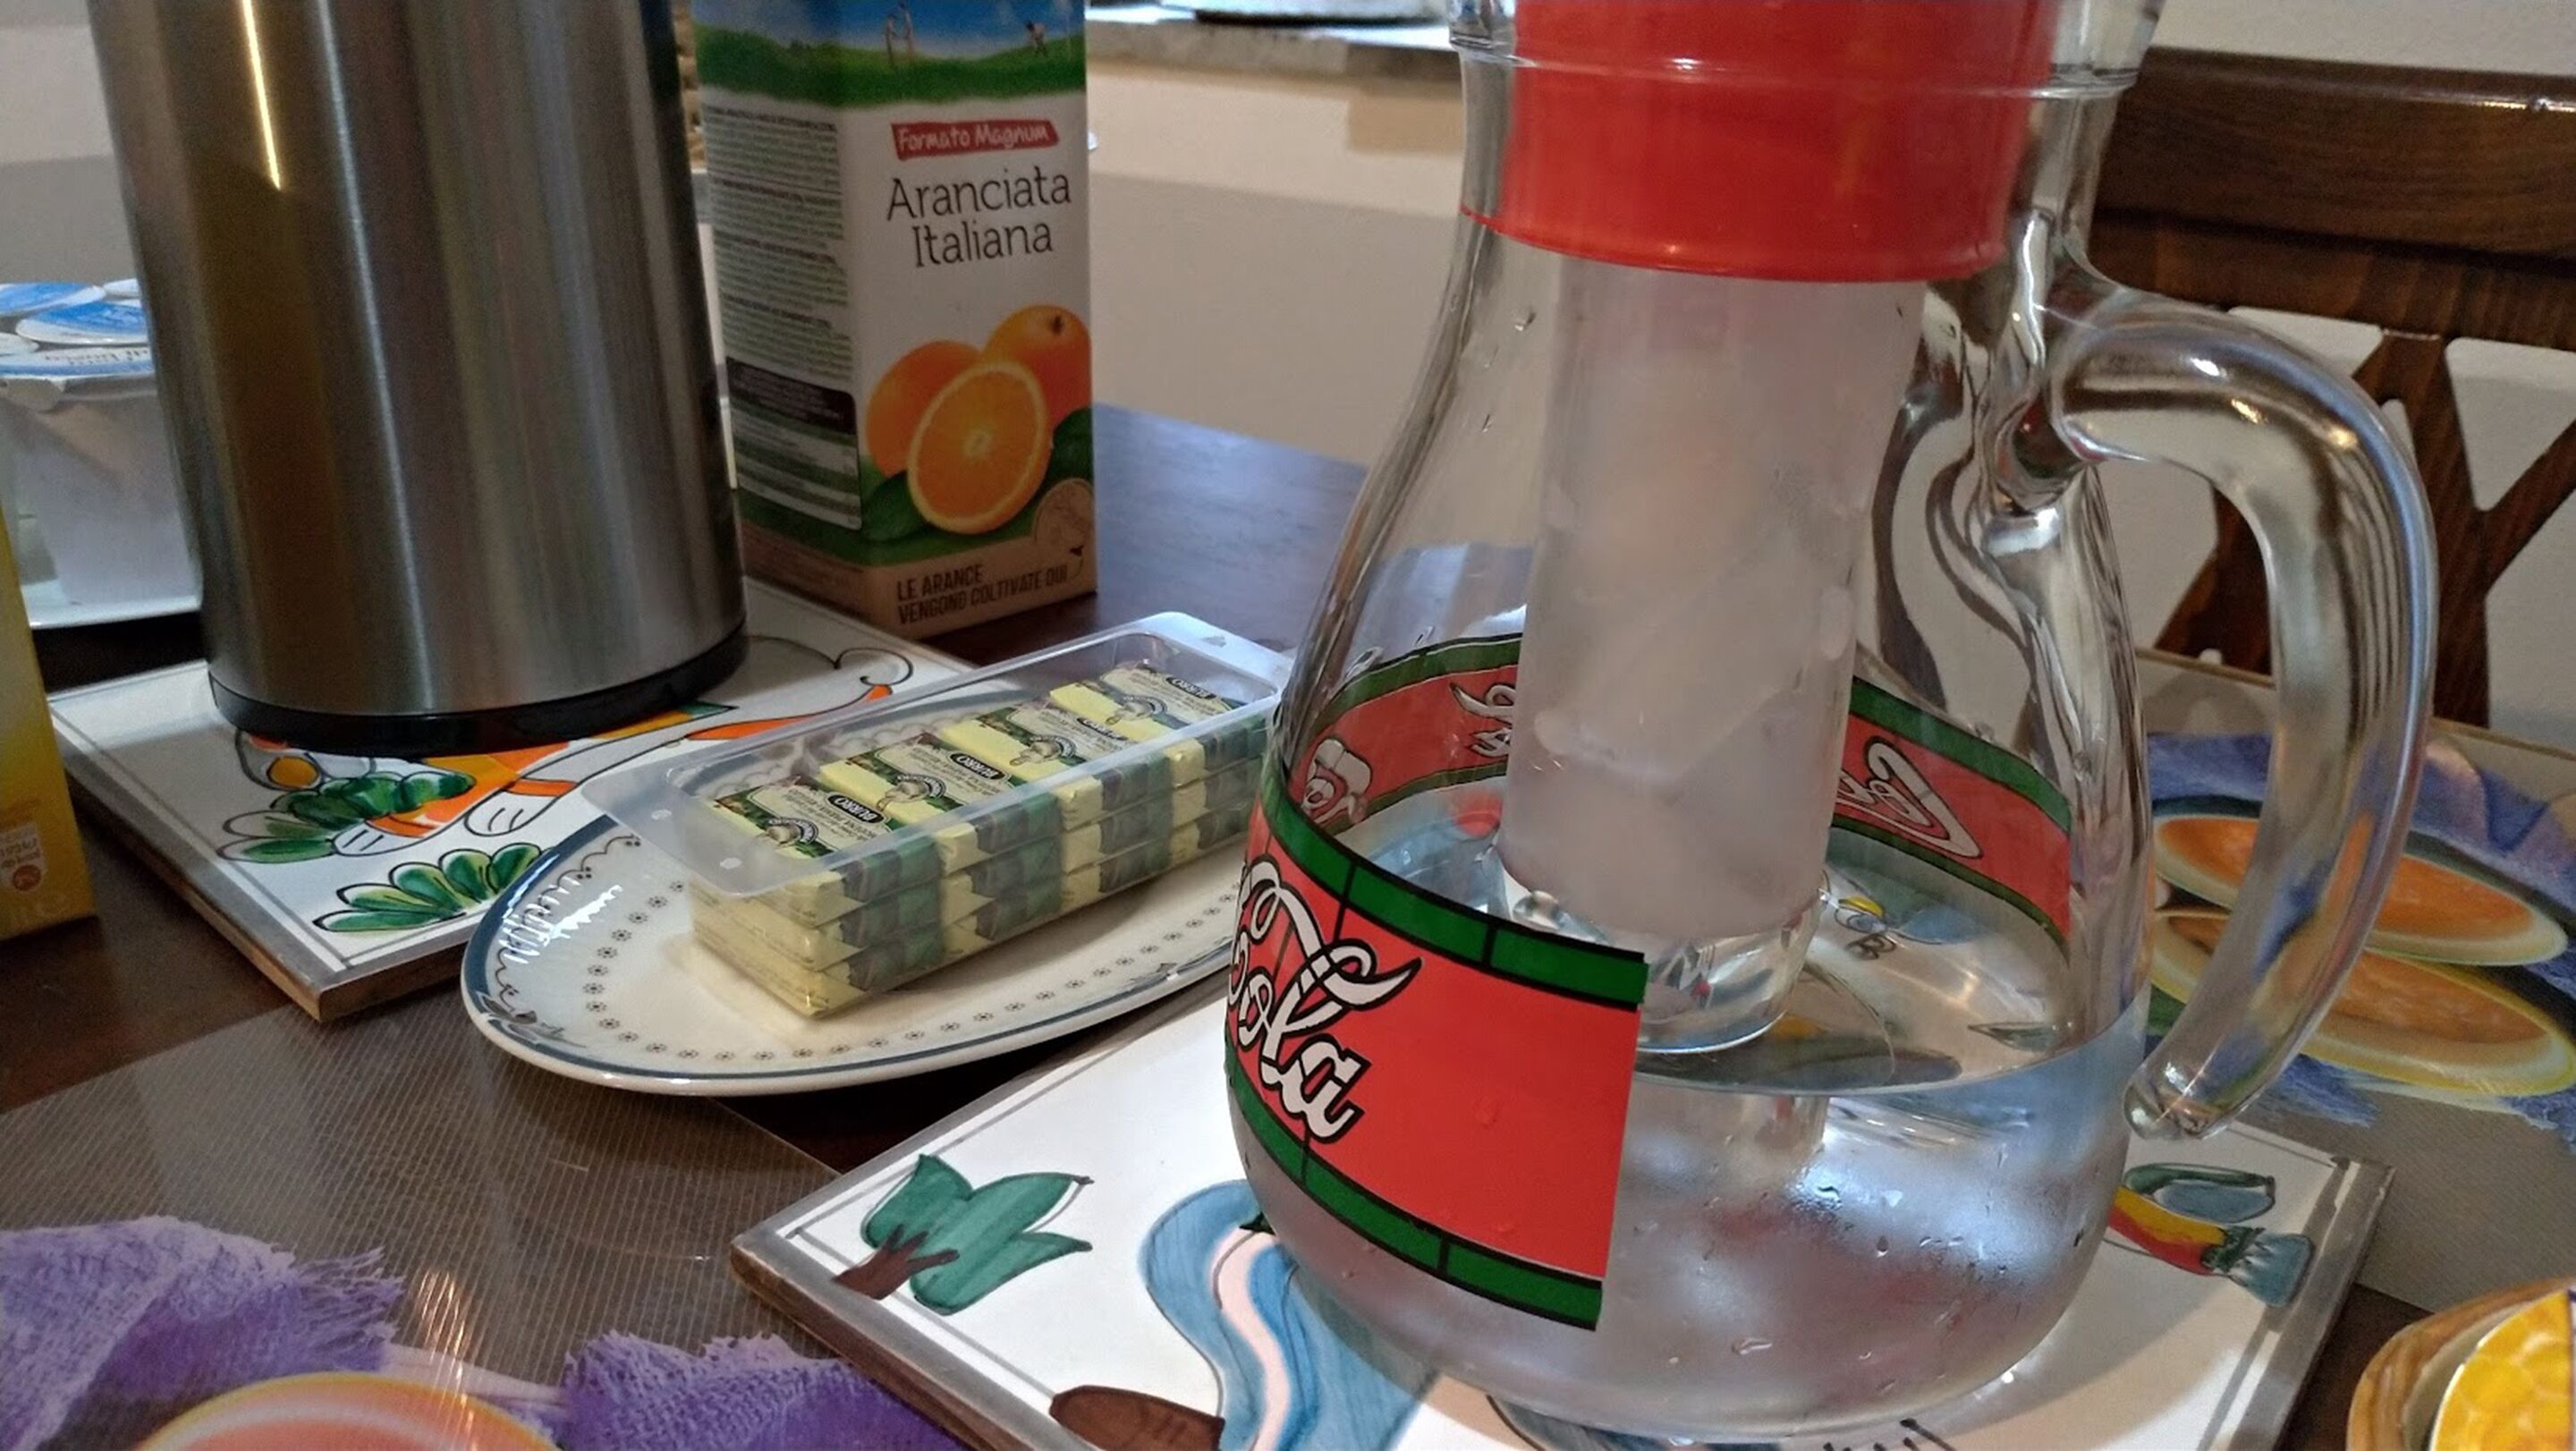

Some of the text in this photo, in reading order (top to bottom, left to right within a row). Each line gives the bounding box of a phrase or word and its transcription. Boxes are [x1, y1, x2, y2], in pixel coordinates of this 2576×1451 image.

[897, 123, 1050, 153] Formato Magnum
[886, 165, 1072, 222] Aranciata
[911, 220, 1055, 268] Italiana
[896, 564, 984, 602] LE ARANCE
[897, 564, 1068, 625] VENGONO COLTIVATE QUI
[834, 796, 877, 821] BURRO
